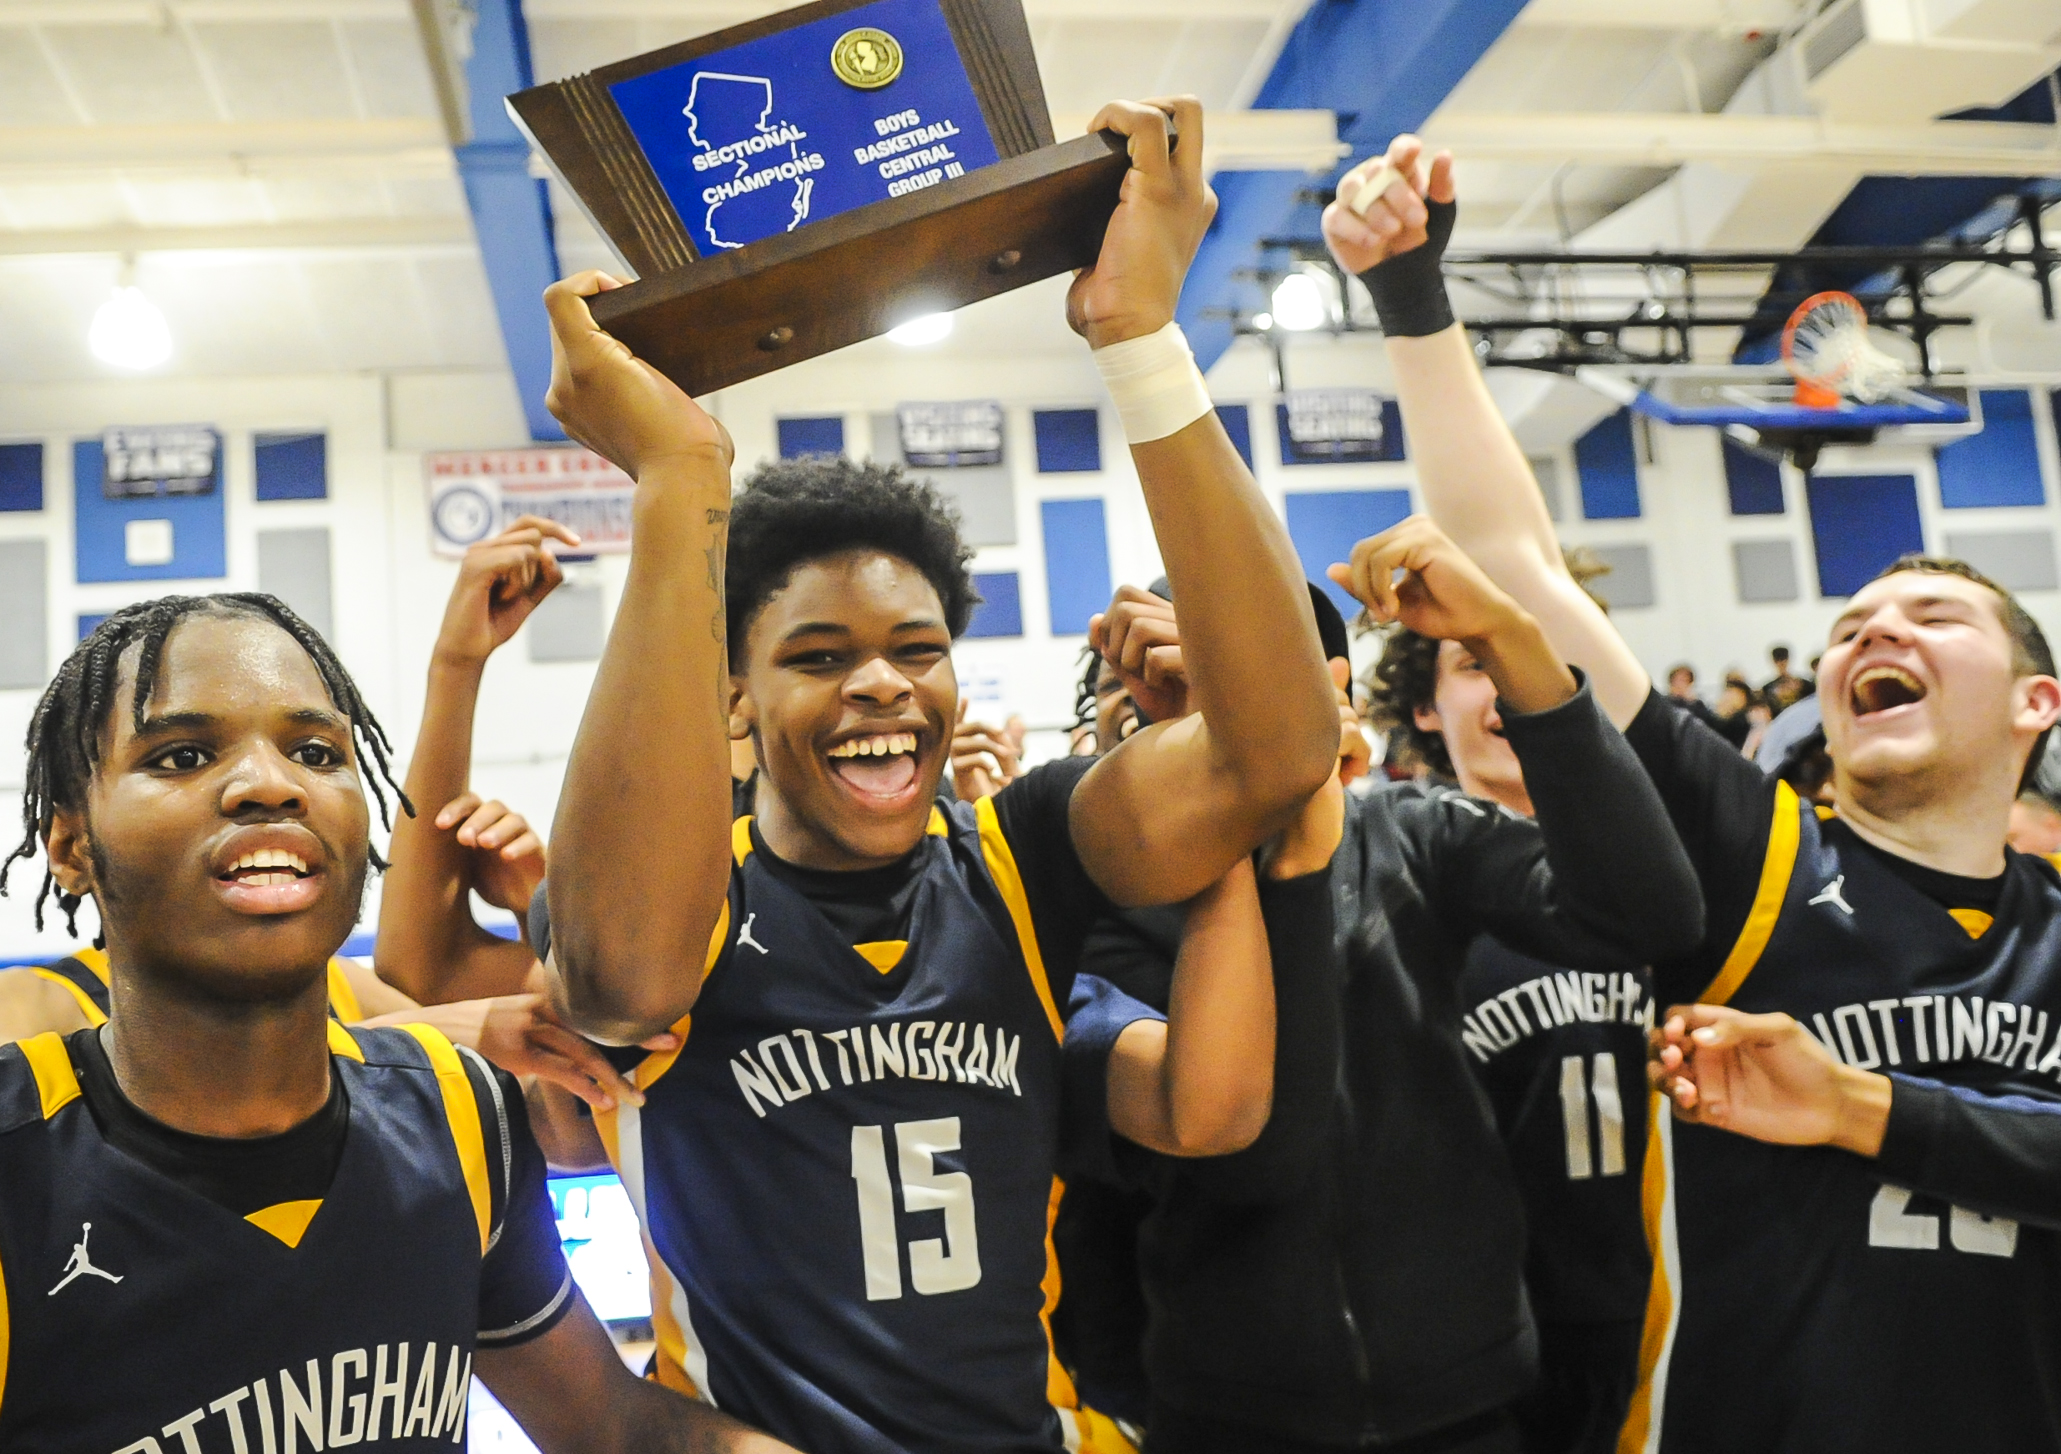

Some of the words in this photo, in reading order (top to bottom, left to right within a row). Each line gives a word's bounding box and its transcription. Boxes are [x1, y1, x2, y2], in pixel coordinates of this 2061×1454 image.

[853, 119, 960, 165] BASKETBALL
[874, 108, 920, 136] BOYS
[692, 124, 807, 172] SECTIONAL
[879, 143, 956, 179] CENTRAL
[702, 153, 825, 204] CHAMPIONS
[887, 168, 943, 198] GROUP
[944, 161, 965, 180] III
[730, 1020, 1022, 1118] NOTTINGHAM
[1559, 1052, 1626, 1180] 11
[851, 1116, 982, 1302] 15
[111, 1341, 472, 1454] TTINGHAM
